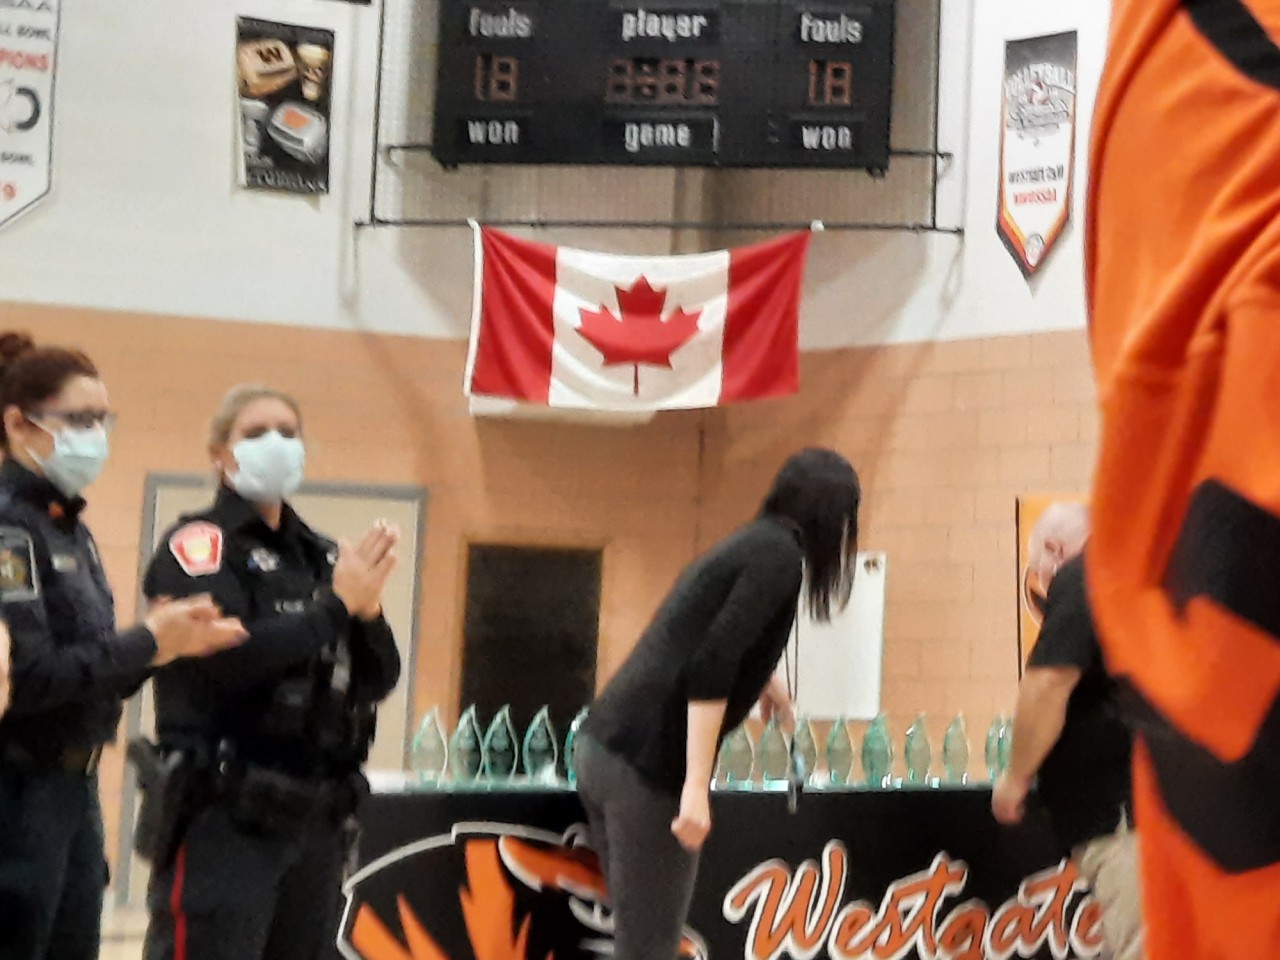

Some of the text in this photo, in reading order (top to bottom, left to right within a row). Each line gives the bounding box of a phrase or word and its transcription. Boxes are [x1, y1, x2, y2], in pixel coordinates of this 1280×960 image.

[621, 8, 708, 41] player
[800, 12, 863, 43] fouls
[467, 120, 520, 145] won
[624, 121, 691, 153] game
[801, 125, 853, 151] won
[722, 838, 1104, 960] Westgate
